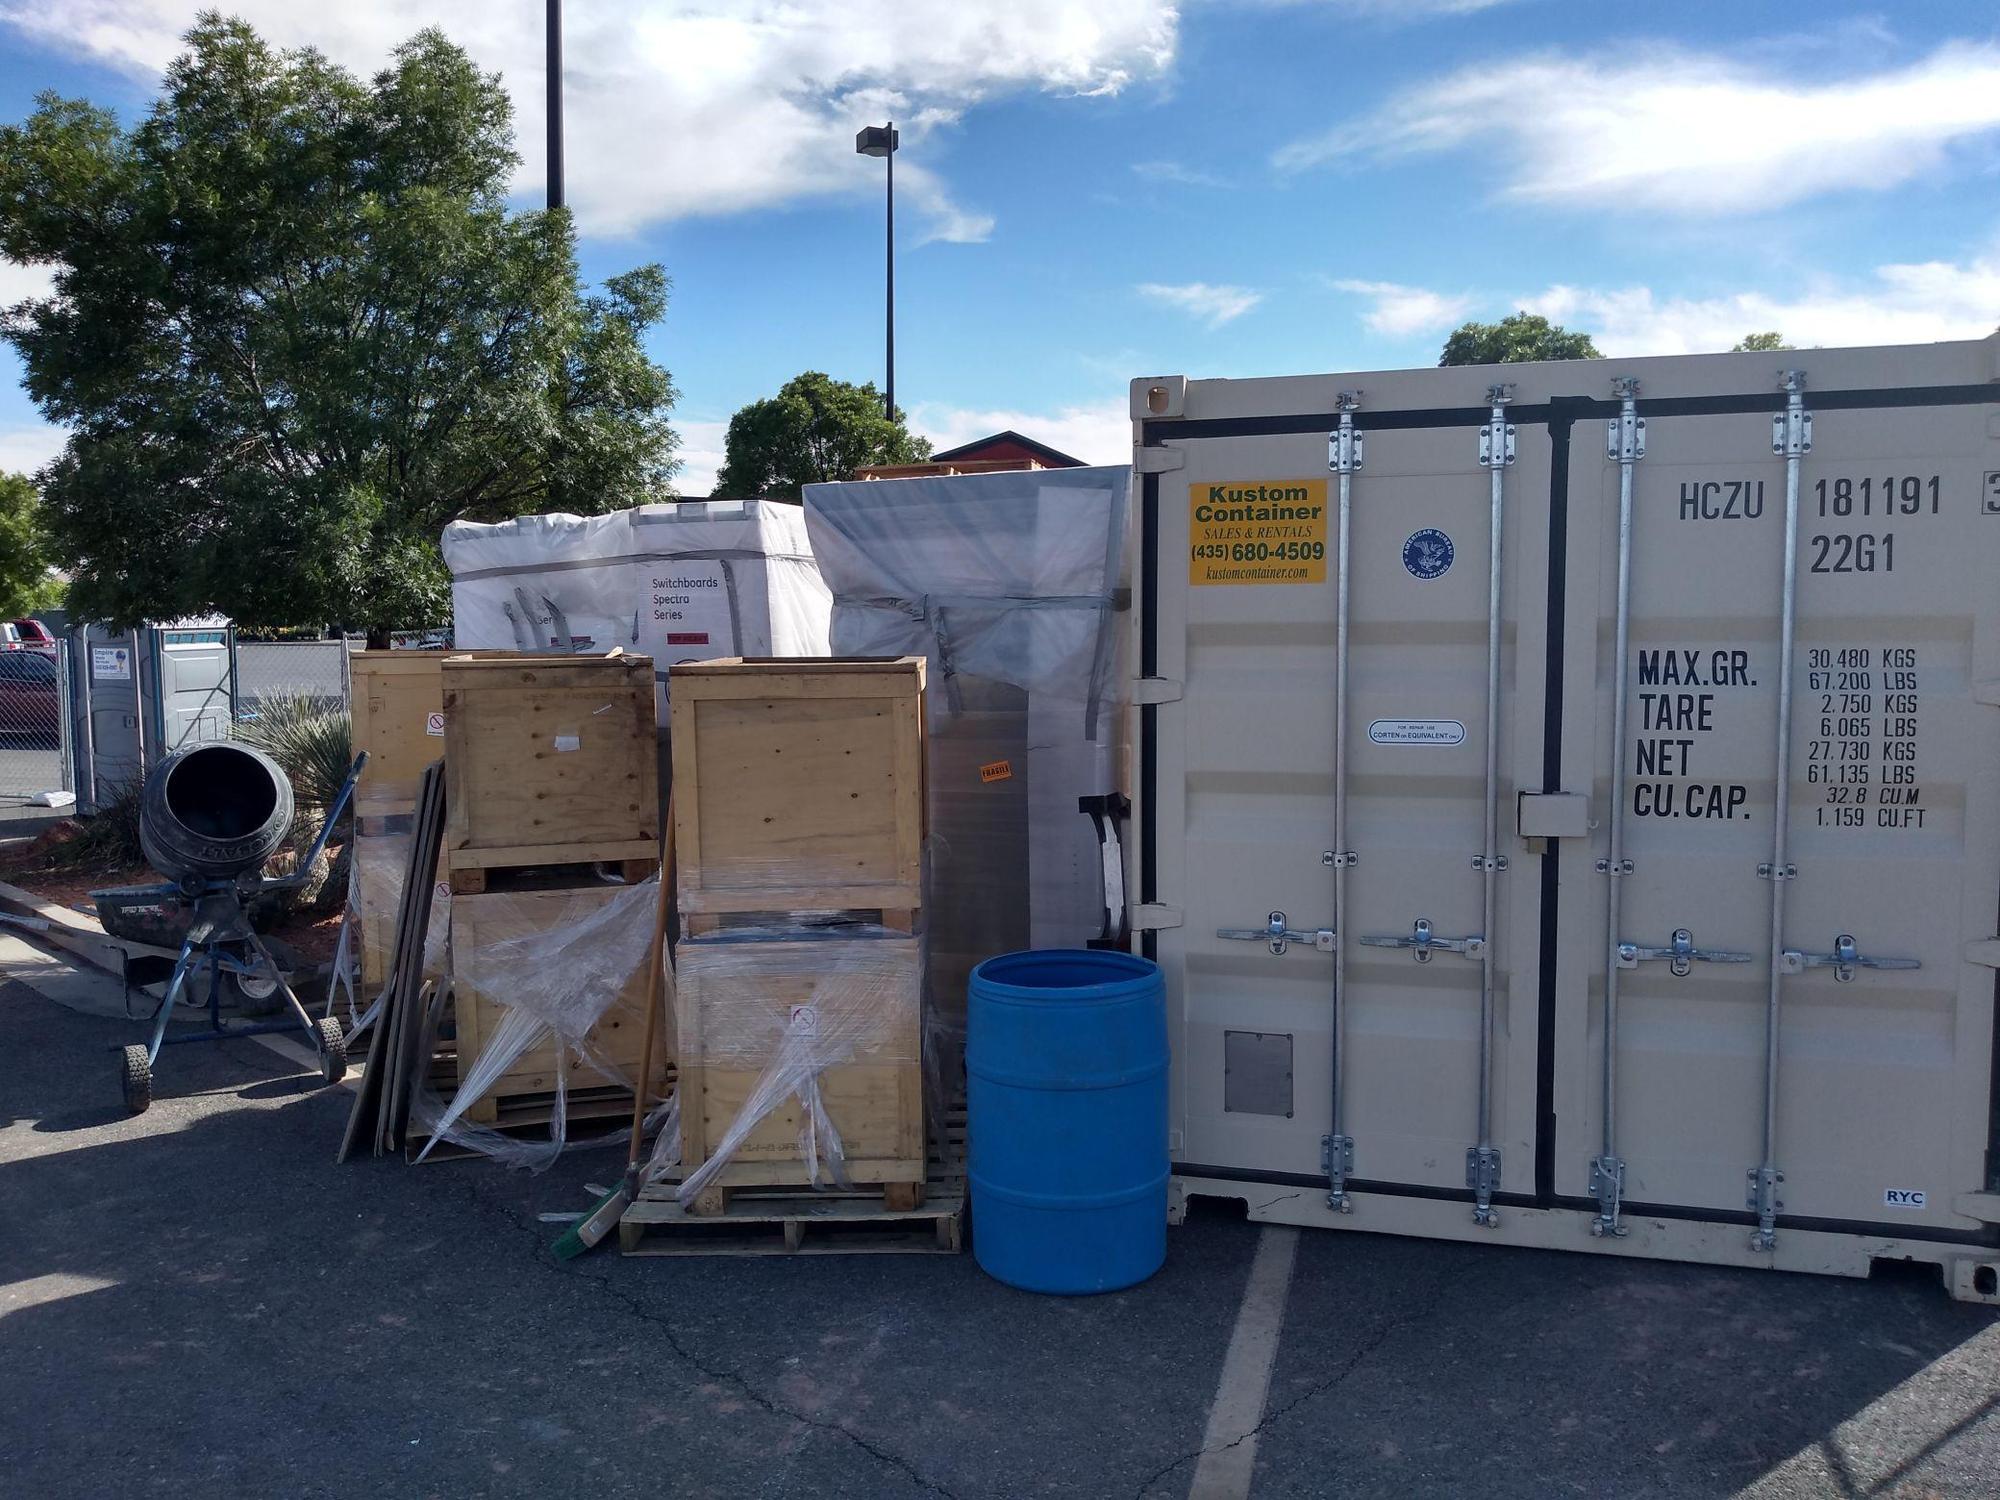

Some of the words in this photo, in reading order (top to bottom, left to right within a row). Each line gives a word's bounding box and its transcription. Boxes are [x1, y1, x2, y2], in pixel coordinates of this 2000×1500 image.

[1209, 486, 1308, 503] Kustom
[1680, 481, 1764, 520] HCZU
[1815, 475, 1940, 517] 181191
[1195, 503, 1322, 523] Container
[1203, 527, 1242, 540] SALES
[1244, 528, 1253, 539] &
[1257, 525, 1312, 539] RENTALS
[1404, 529, 1433, 555] AMERICAN
[1435, 531, 1454, 555] BUREAU
[1191, 543, 1229, 562] (435)
[1232, 541, 1325, 561] 680-4509
[1811, 533, 1894, 573] 22G1
[1206, 564, 1308, 580] kustomcontainer.com
[1416, 564, 1449, 579] SHIPPING
[653, 577, 718, 589] Switchboards
[653, 594, 690, 607] Spectra
[654, 609, 683, 620] Series
[1638, 650, 1757, 686] MAX.GR.
[1808, 648, 1870, 668] 30.480
[1883, 648, 1916, 668] KGS
[1809, 672, 1871, 690] 67.200
[1883, 672, 1917, 690] LBS
[1639, 693, 1714, 731] TARE
[1821, 694, 1871, 713] 2.750
[1884, 694, 1918, 713] KGS
[1373, 731, 1400, 739] CORTEN
[1408, 731, 1448, 739] EQUIVALENT
[1820, 717, 1871, 737] 6.065
[1883, 717, 1917, 737] LBS
[1636, 739, 1694, 776] NET
[1808, 741, 1870, 760] 27.730
[1883, 741, 1916, 761] KGS
[1808, 764, 1869, 784] 61.135
[1882, 765, 1916, 784] LBS
[1633, 783, 1751, 820] CU.CAP.
[1826, 786, 1867, 804] 32.8
[1879, 787, 1920, 805] CU.M
[1816, 807, 1864, 827] 1.159
[1878, 808, 1926, 828] CU.FT
[1887, 1190, 1924, 1204] RYC
